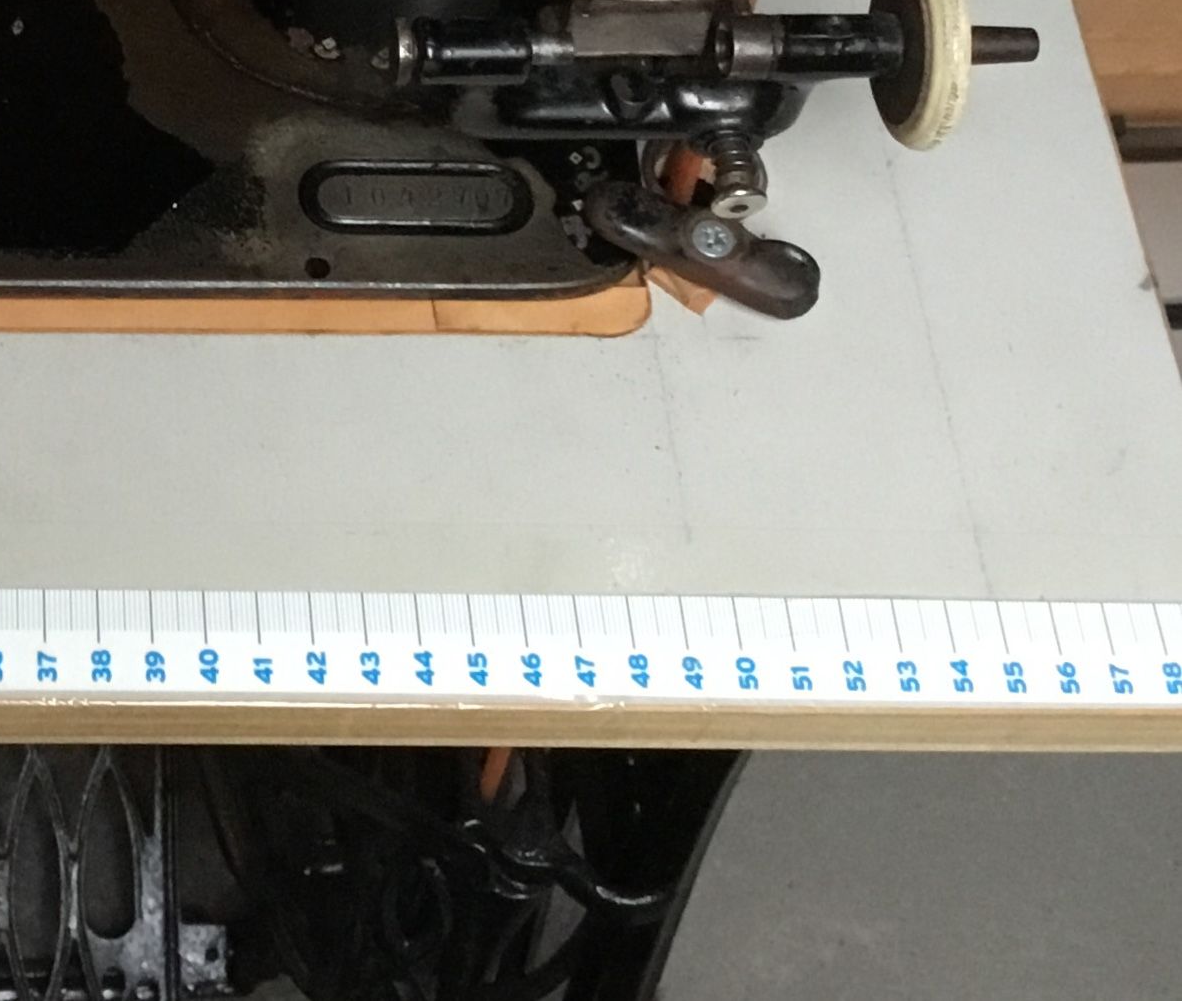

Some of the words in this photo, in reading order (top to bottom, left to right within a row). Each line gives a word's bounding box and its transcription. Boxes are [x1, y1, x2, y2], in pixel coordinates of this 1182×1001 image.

[35, 650, 59, 682] 37
[89, 648, 114, 683] 38
[144, 649, 167, 683] 39
[197, 647, 221, 685] 40
[251, 656, 275, 685] 41
[305, 650, 329, 686] 42
[358, 650, 382, 686] 43
[412, 649, 435, 687] 44
[465, 651, 490, 688] 45
[519, 652, 544, 689] 46
[573, 654, 598, 689] 47
[627, 652, 651, 690] 48
[681, 655, 705, 691] 49
[734, 655, 760, 691] 50
[789, 665, 814, 692] 51
[842, 660, 867, 692] 52
[896, 660, 921, 693] 53
[949, 658, 975, 694] 54
[1002, 661, 1027, 695] 55
[1057, 661, 1082, 695] 56
[1108, 664, 1134, 695] 57
[1161, 661, 1182, 695] 58
